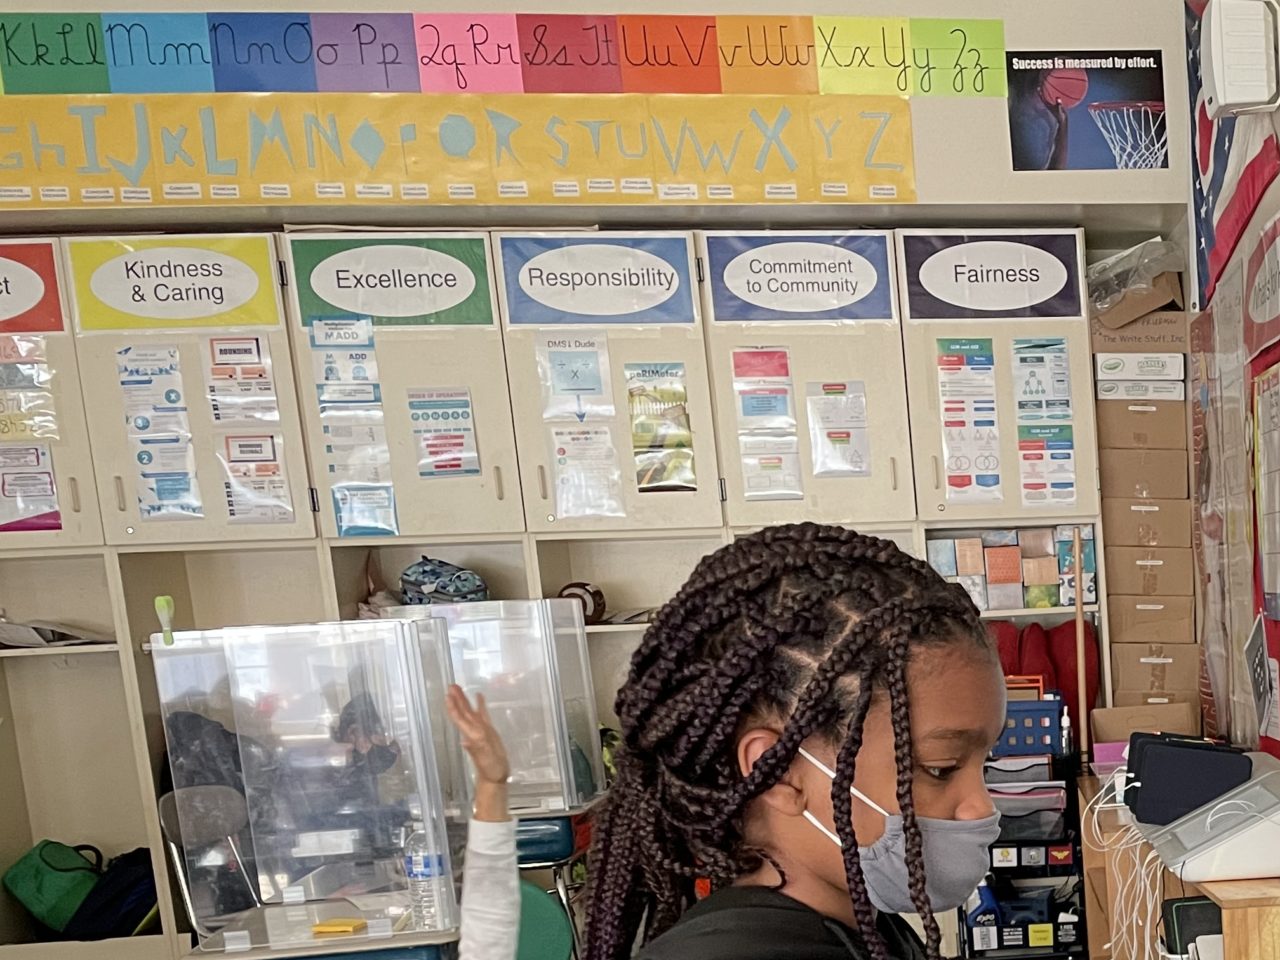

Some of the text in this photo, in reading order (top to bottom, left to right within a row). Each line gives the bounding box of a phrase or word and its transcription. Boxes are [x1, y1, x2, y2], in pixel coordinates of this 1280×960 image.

[1012, 57, 1157, 70] Success is measured by effort.
[124, 260, 224, 280] Kindness
[749, 258, 854, 276] Commitment
[953, 264, 1041, 284] Fairness
[335, 268, 458, 290] Excellence
[527, 266, 675, 291] Responsibility
[746, 278, 859, 296] to Community
[131, 283, 225, 305] & Caring
[574, 340, 596, 348] Dude
[1103, 335, 1117, 343] The
[1120, 335, 1142, 343] Write
